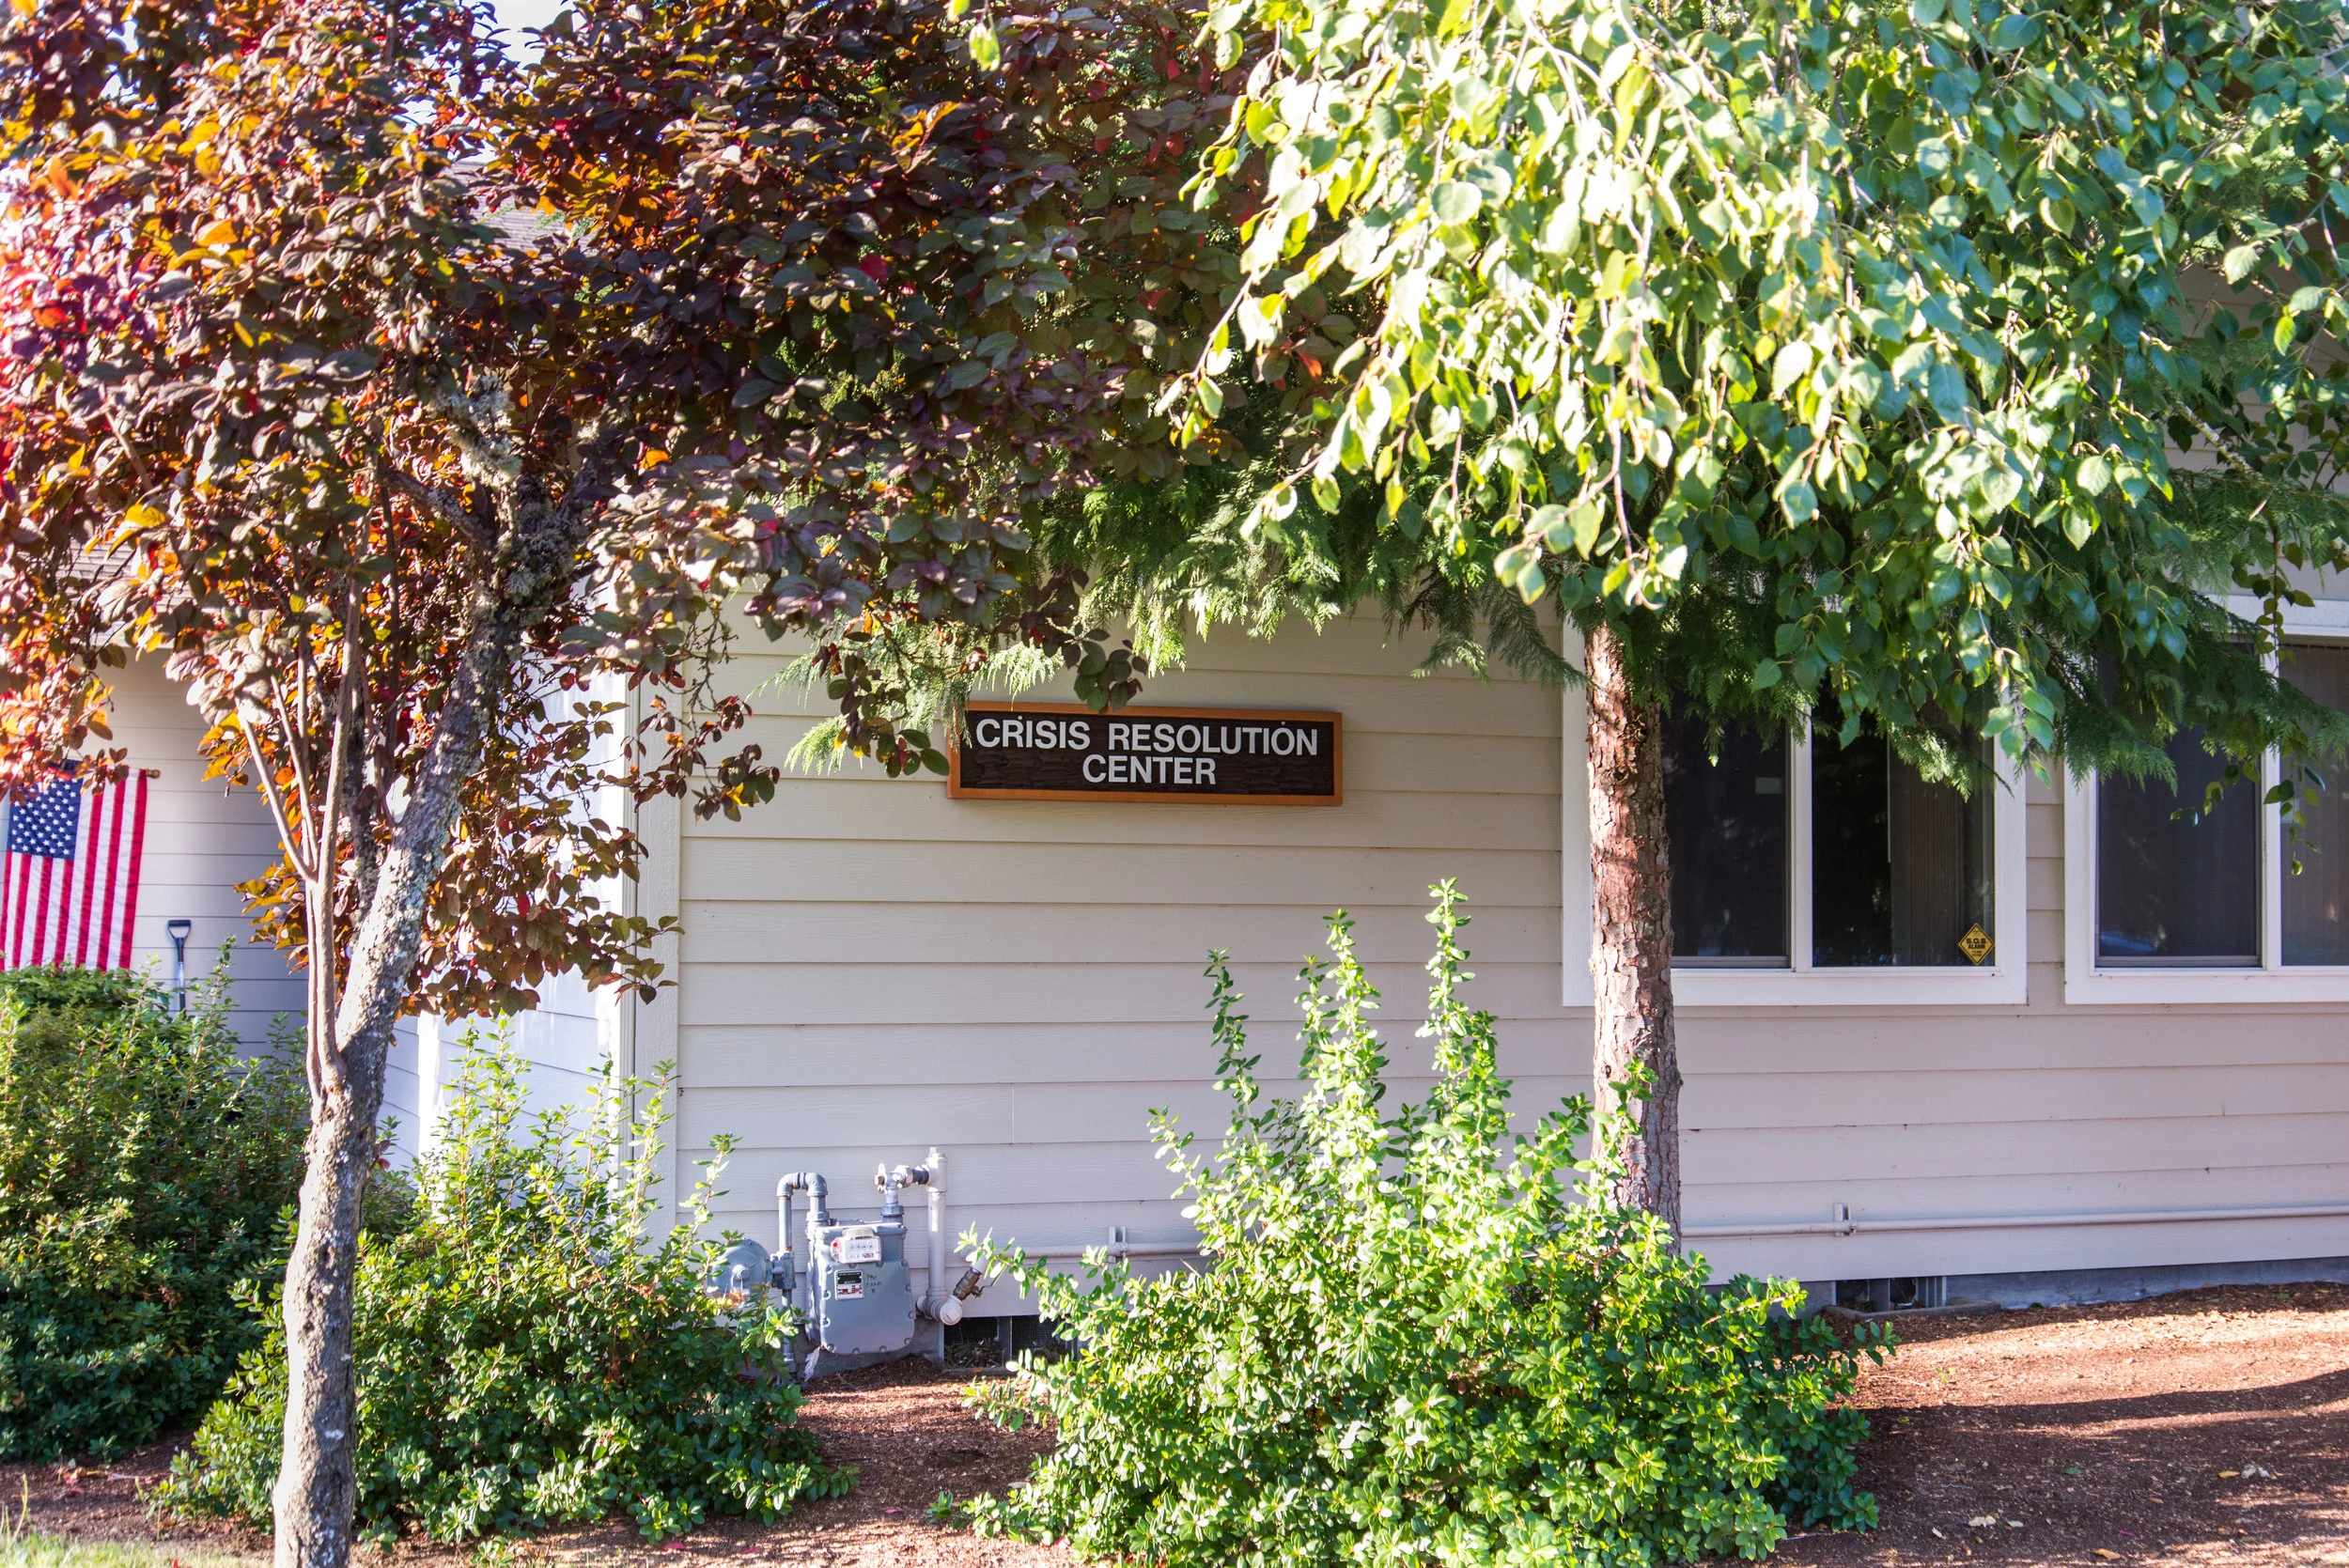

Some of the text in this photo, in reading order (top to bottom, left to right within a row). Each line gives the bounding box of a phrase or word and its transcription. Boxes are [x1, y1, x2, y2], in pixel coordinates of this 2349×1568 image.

[975, 718, 1317, 755] CRISIS RESOLUTION
[1082, 754, 1217, 785] CENTER
